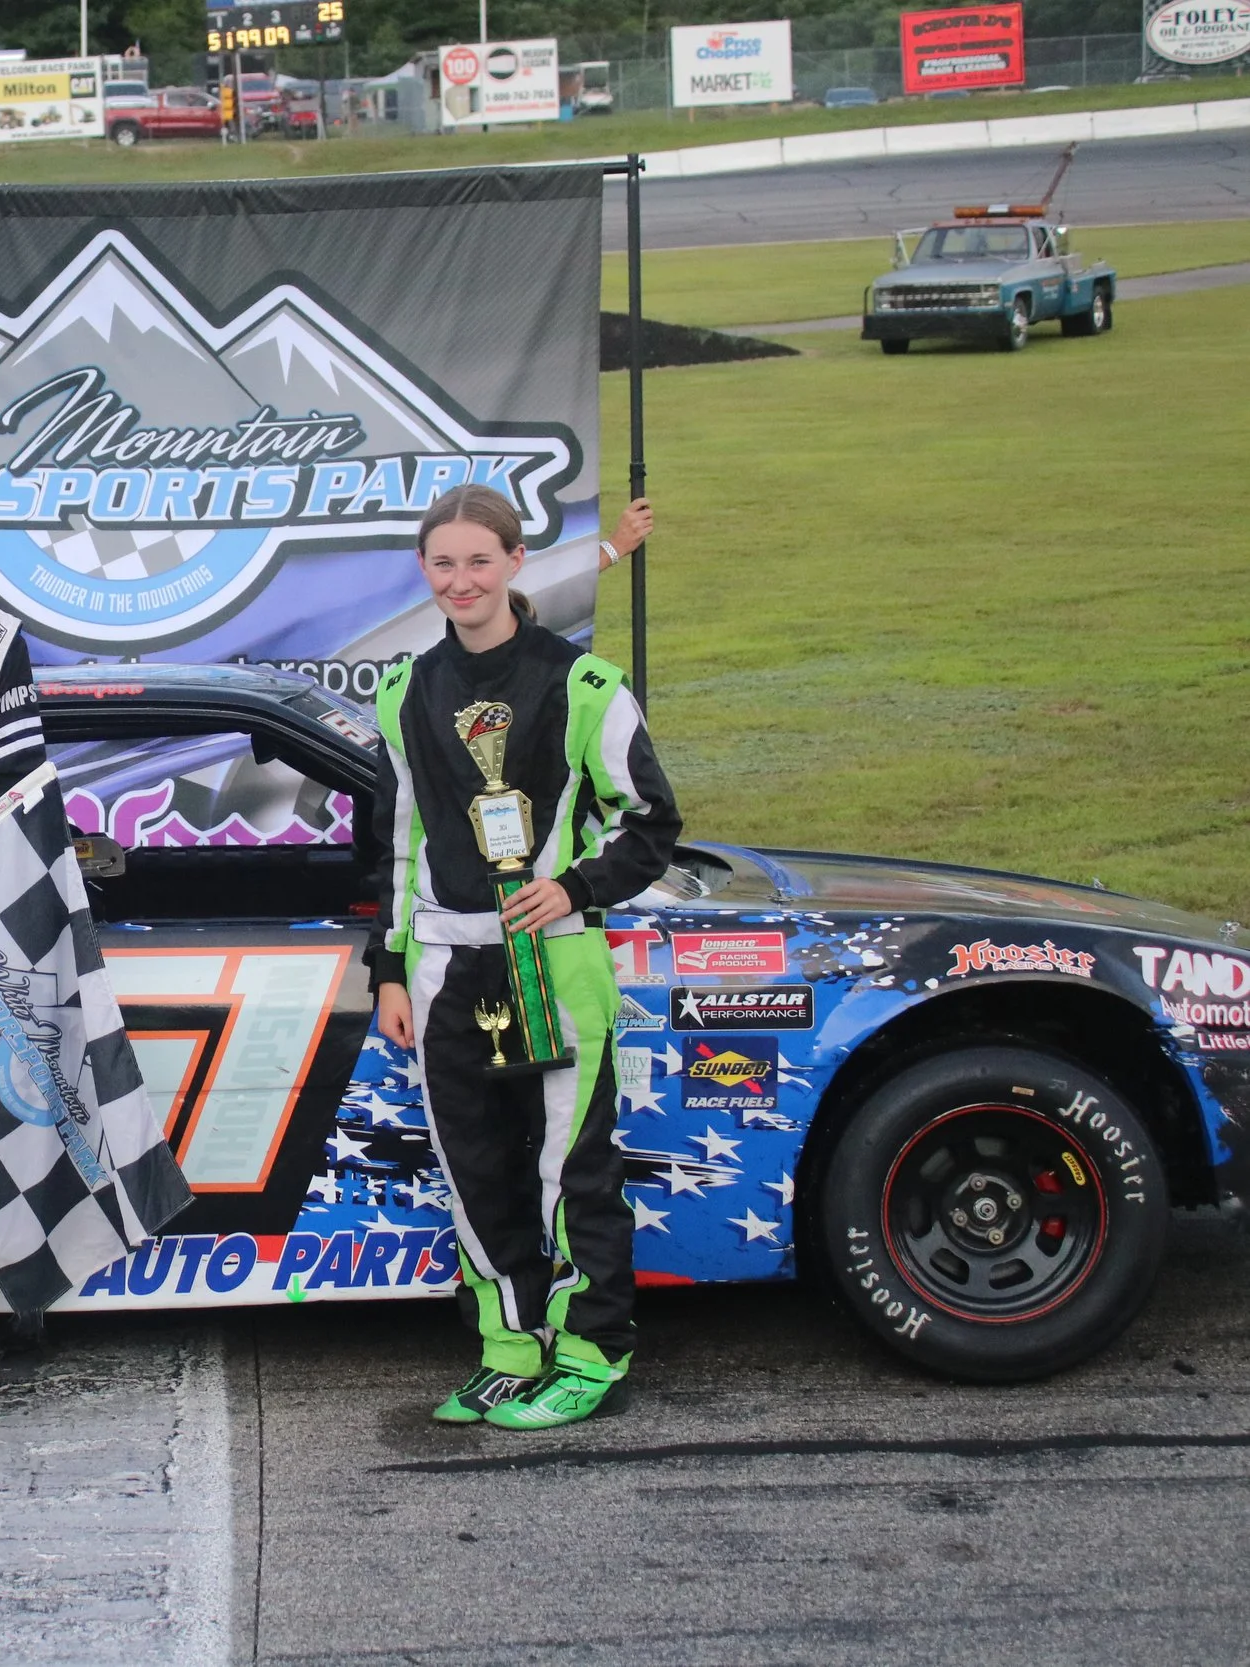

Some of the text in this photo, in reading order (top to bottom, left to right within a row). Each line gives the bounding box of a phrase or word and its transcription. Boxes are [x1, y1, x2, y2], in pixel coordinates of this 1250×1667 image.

[317, 2, 343, 22] 25
[1174, 8, 1237, 25] FOLEY
[1160, 27, 1177, 37] OIL
[724, 36, 761, 48] Price
[697, 46, 761, 59] Chopper
[40, 63, 65, 72] RACE
[447, 58, 476, 76] 100
[3, 83, 56, 97] Milton
[71, 78, 94, 94] CAT
[691, 72, 752, 93] MARKET
[0, 367, 367, 478] Mountain
[297, 454, 538, 518] PARK
[29, 564, 214, 612] THUNDER IN THE MOUNTAINS
[490, 847, 526, 859] 2nd Place
[701, 938, 757, 951] Longacre
[946, 938, 1096, 977] Hoosier
[992, 961, 1092, 978] RACING TIRE
[700, 993, 805, 1006] ALLSTAR
[702, 1009, 807, 1019] PERFORMANCE
[26, 1019, 91, 1126] Mountain
[690, 1059, 772, 1079] SUNOCO
[685, 1096, 776, 1108] RACE FUELS
[58, 1117, 112, 1189] PARK
[1058, 1090, 1145, 1204] Hoosier
[78, 1228, 460, 1299] AUTO PARTS
[847, 1226, 933, 1340] Hoosier
